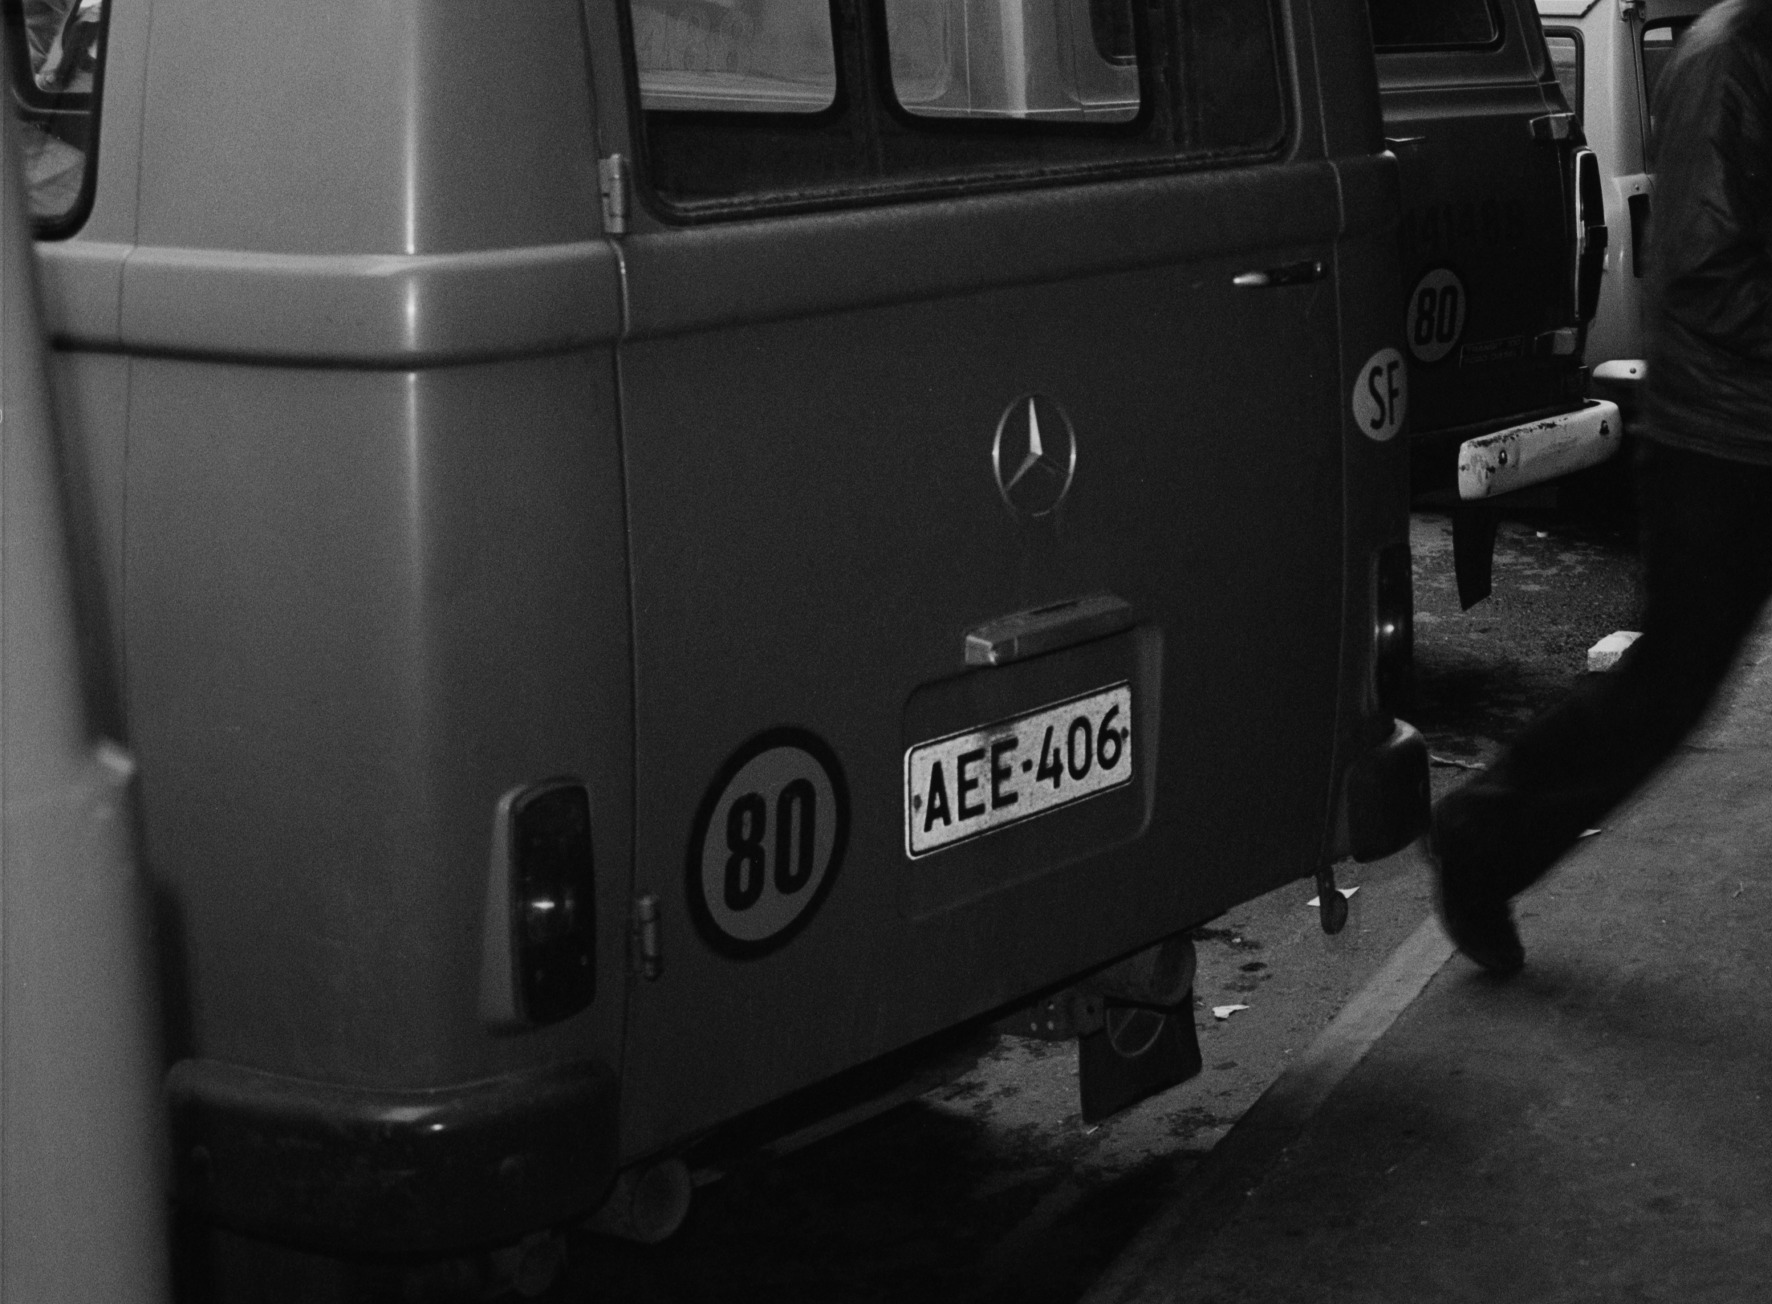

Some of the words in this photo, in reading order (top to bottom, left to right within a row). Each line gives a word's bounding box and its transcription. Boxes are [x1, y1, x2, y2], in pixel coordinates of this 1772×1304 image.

[1414, 286, 1459, 346] 80
[1368, 359, 1400, 430] SF
[723, 778, 816, 911] 80
